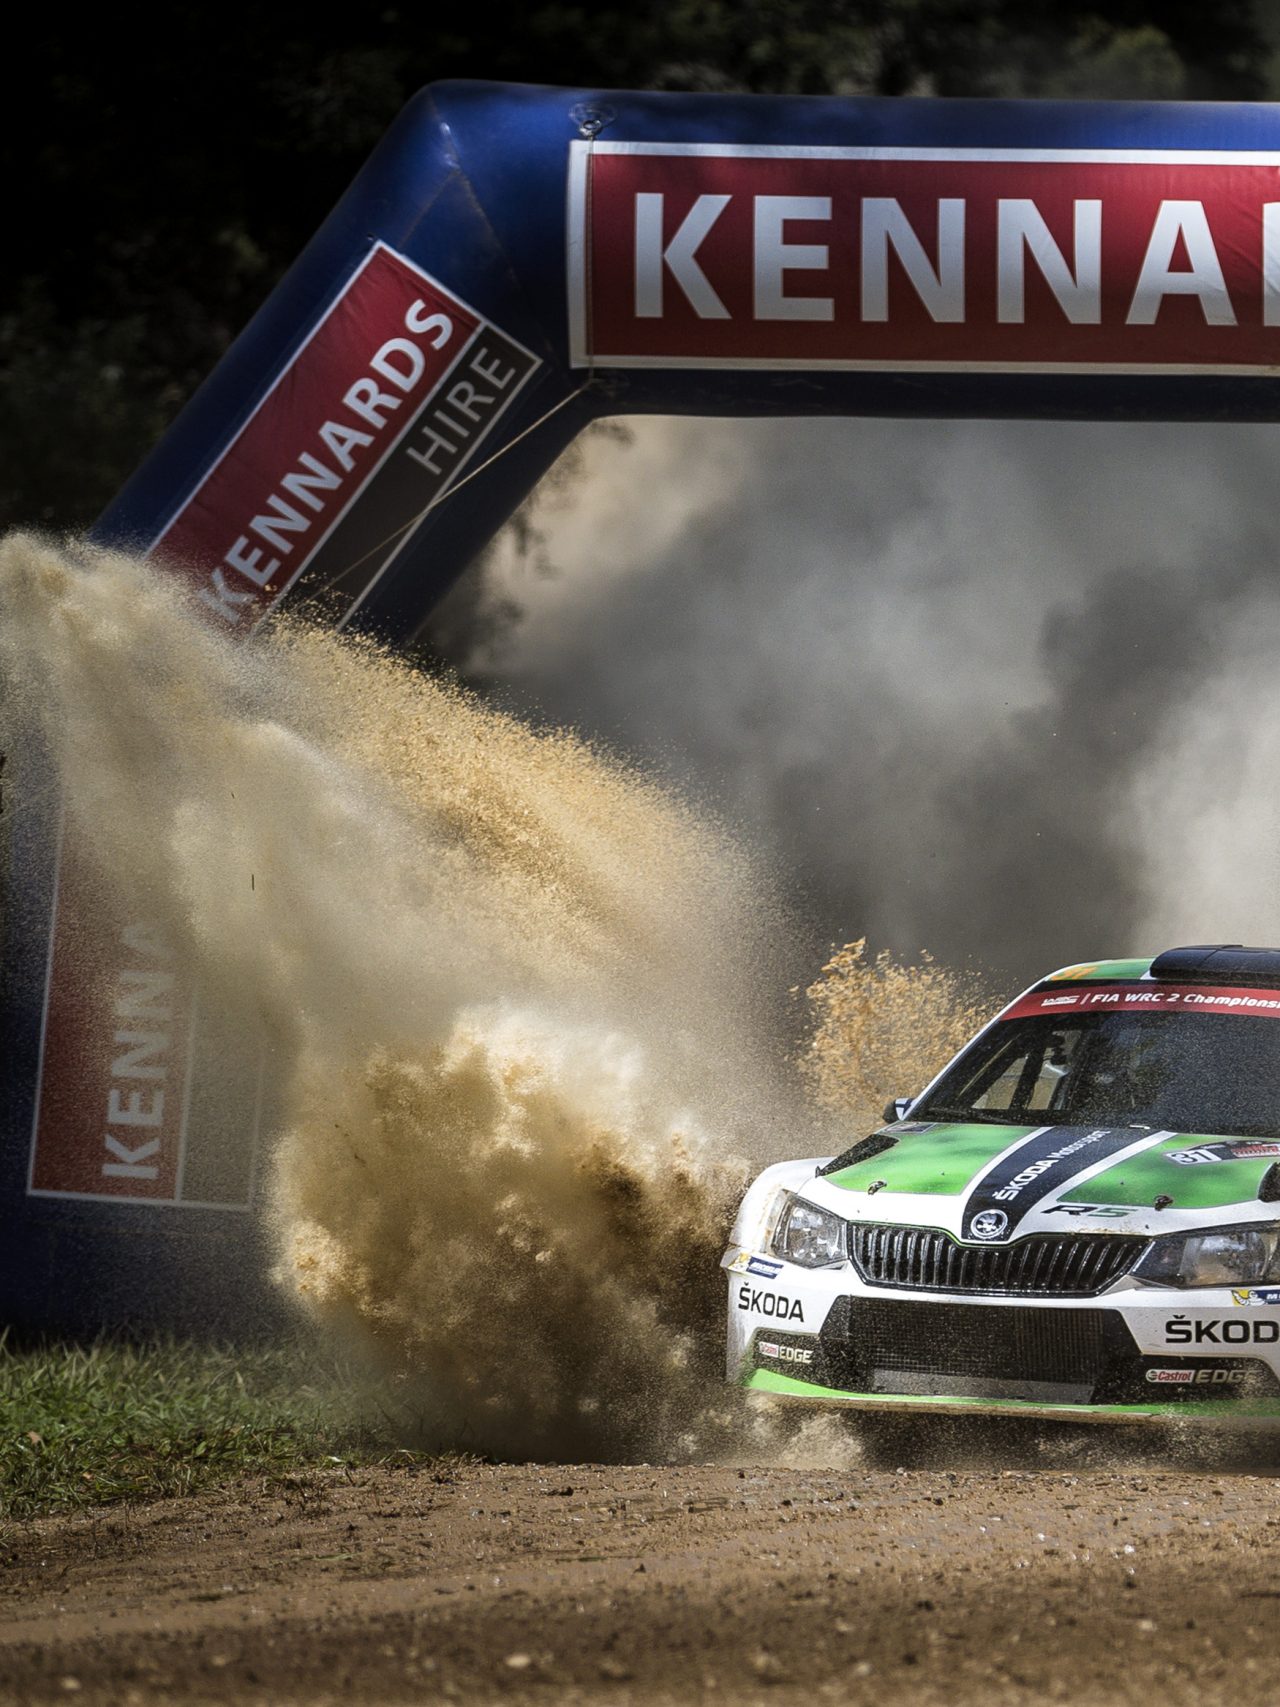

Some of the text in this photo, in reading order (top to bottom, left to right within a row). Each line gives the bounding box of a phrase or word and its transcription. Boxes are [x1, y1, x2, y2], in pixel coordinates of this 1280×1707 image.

[406, 347, 516, 476] HIRE
[201, 299, 454, 623] KENNARDS
[1090, 993, 1120, 1003] FIA
[1124, 992, 1164, 1003] WRC
[1166, 992, 1180, 1003] 2
[101, 920, 175, 1180] KENNA
[991, 1158, 1059, 1201] ŠKODA
[738, 1281, 805, 1323] ŠKODA
[779, 1345, 814, 1364] EDGE
[1157, 1370, 1193, 1382] Castrol
